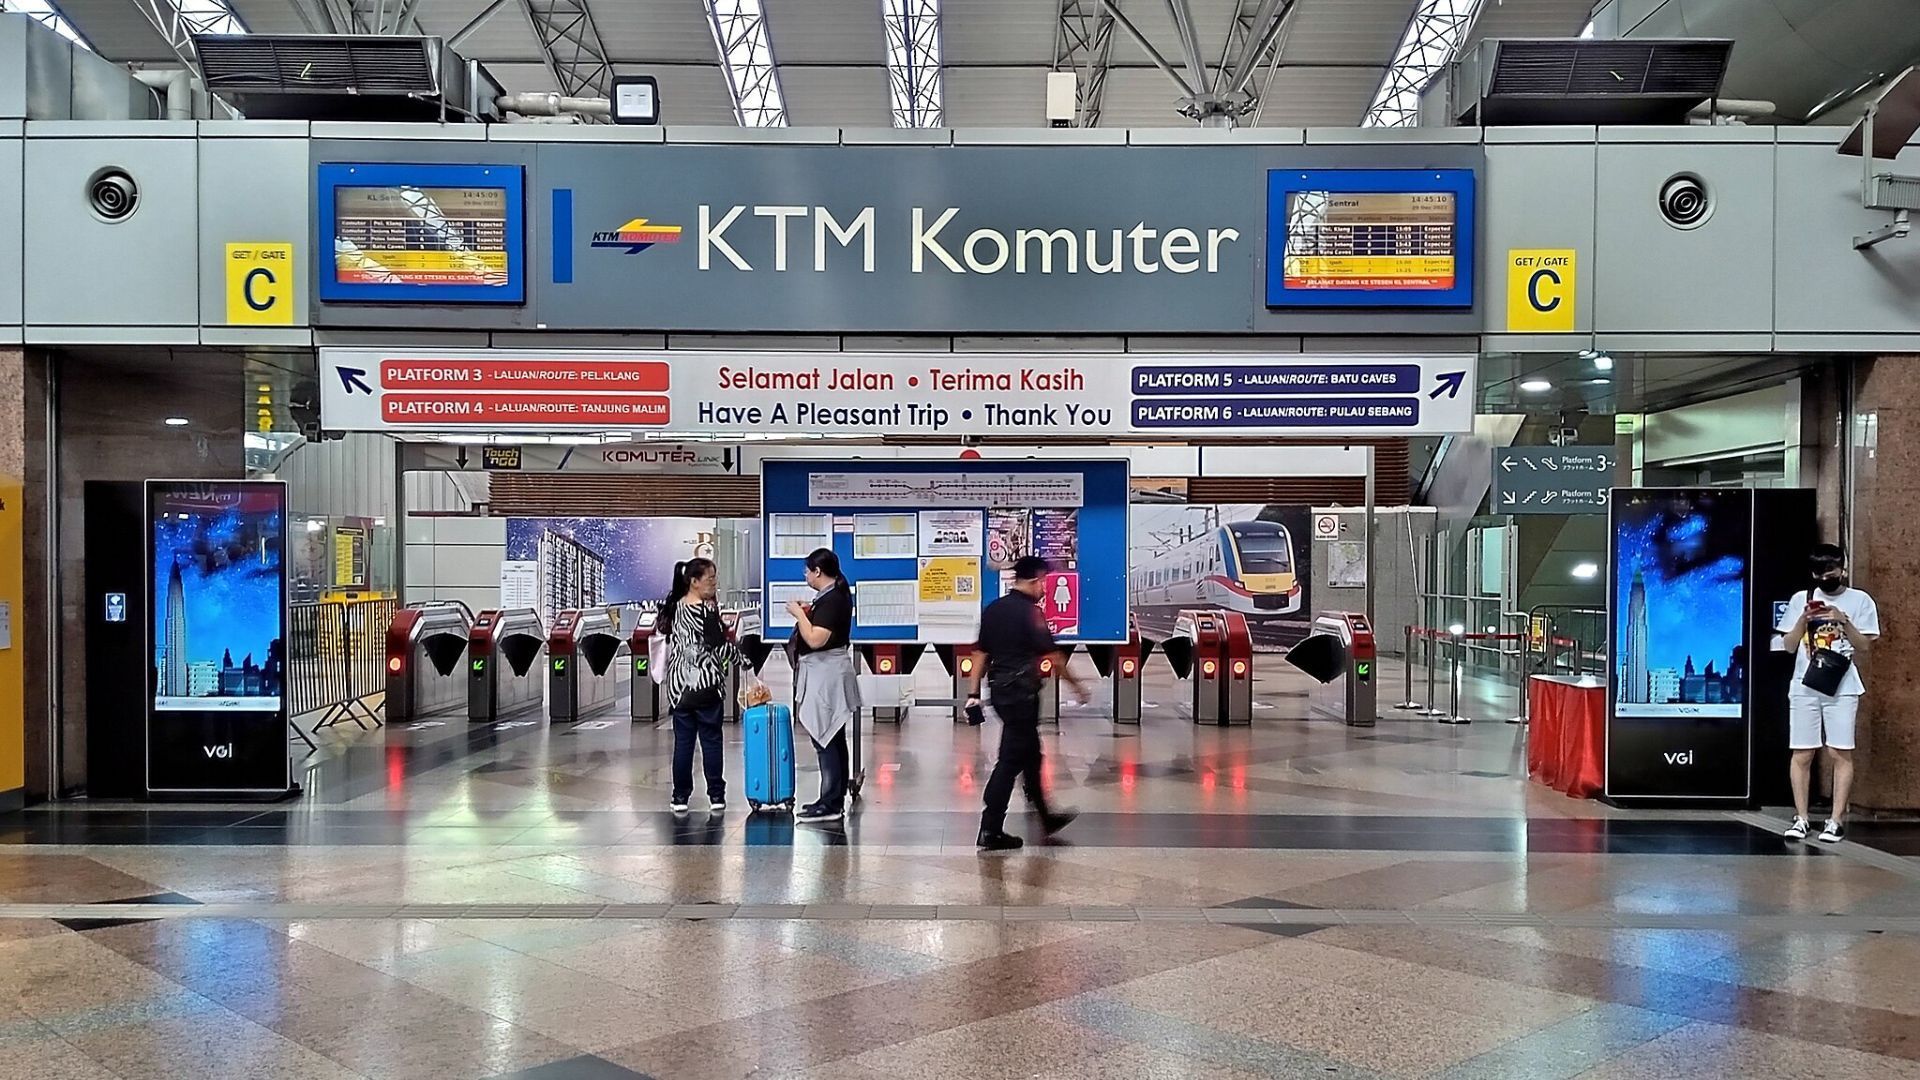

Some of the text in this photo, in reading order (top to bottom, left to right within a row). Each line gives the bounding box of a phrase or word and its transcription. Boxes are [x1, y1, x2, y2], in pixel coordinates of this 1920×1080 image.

[1328, 199, 1359, 207] Sentral
[592, 232, 620, 241] KTM
[698, 205, 1240, 273] KTM Komuter
[232, 250, 252, 260] GET
[260, 250, 286, 260] GATE
[1515, 257, 1534, 266] GET
[1544, 257, 1569, 266] GATE
[244, 267, 276, 311] C
[1528, 268, 1561, 312] C
[388, 368, 470, 381] PLATFORM
[472, 368, 482, 381] 3
[580, 370, 640, 381] PEL.KLANG
[718, 366, 1084, 391] Selamat Jalan Terima Kasih
[1138, 374, 1220, 388] PLATFORM
[1222, 373, 1233, 387] 5
[1331, 374, 1360, 384] BATU
[1362, 374, 1397, 384] CAVES
[388, 402, 470, 414] PLATFORM
[472, 402, 484, 414] 4
[581, 403, 630, 414] TANJUNG
[632, 403, 667, 414] MALIM
[1138, 406, 1220, 420] PLATFORM
[1222, 406, 1232, 420] 6
[1330, 407, 1365, 418] PULAU
[1368, 407, 1413, 418] SEBANG
[698, 402, 1112, 430] Have A Pleasant Trip Thank You
[484, 448, 519, 458] Touch
[1562, 456, 1592, 464] Platform
[1562, 490, 1592, 498] Platform
